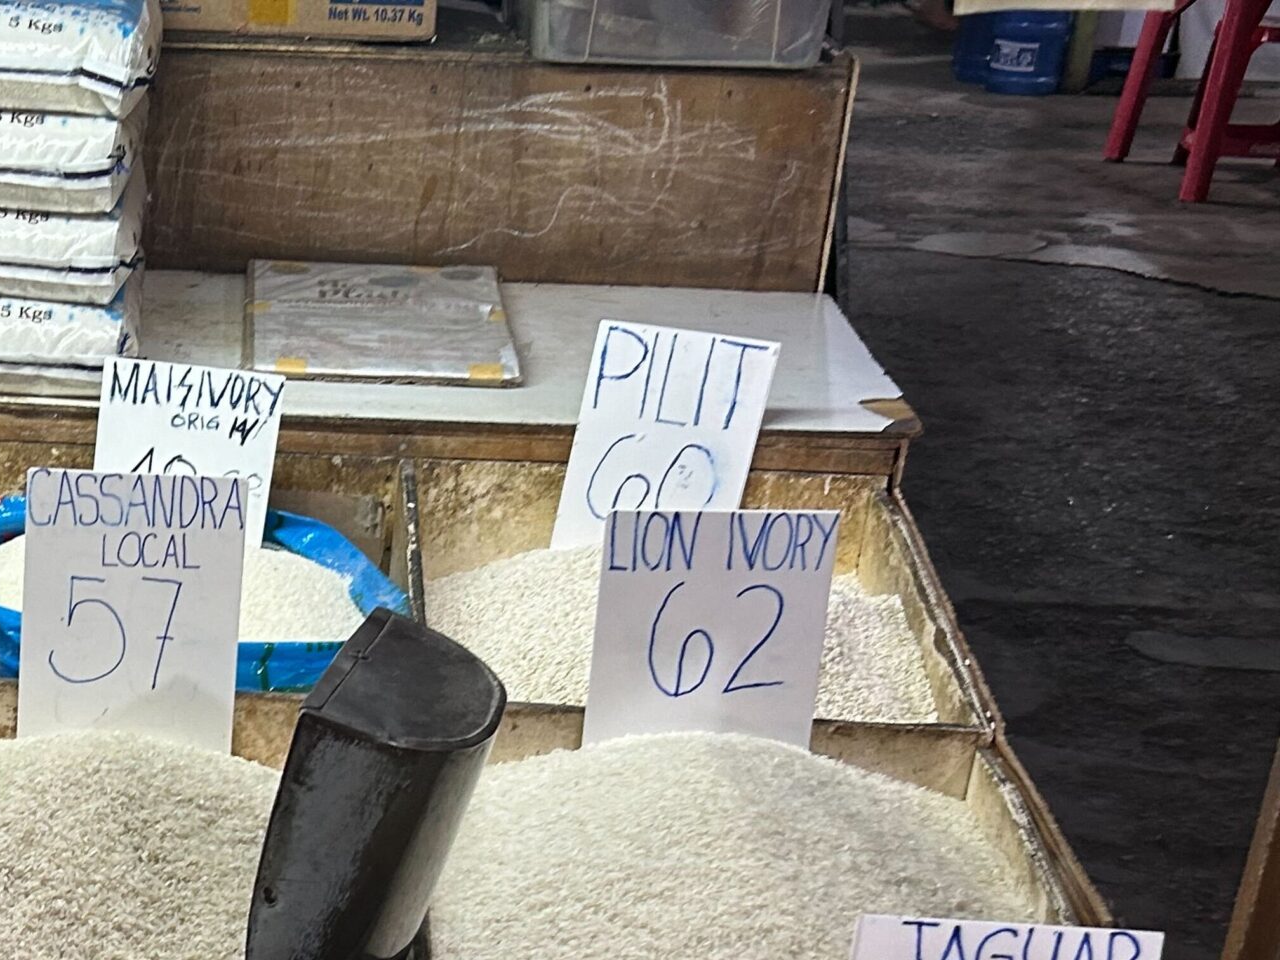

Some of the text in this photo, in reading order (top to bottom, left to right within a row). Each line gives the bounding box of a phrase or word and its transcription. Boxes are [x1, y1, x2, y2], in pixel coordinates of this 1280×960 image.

[9, 16, 20, 28] 5
[28, 20, 63, 34] Kgs
[326, 7, 348, 20] Net
[408, 9, 423, 25] Kg
[0, 307, 11, 318] 5
[19, 307, 53, 323] Kgs
[593, 326, 770, 430] PILIT
[170, 412, 220, 430] ORIG
[28, 468, 245, 530] CASSANDRA
[586, 434, 717, 522] 60
[101, 531, 201, 570] LOCAL
[608, 510, 841, 572] LION IVORY
[48, 575, 183, 691] 57
[648, 581, 784, 698] 62
